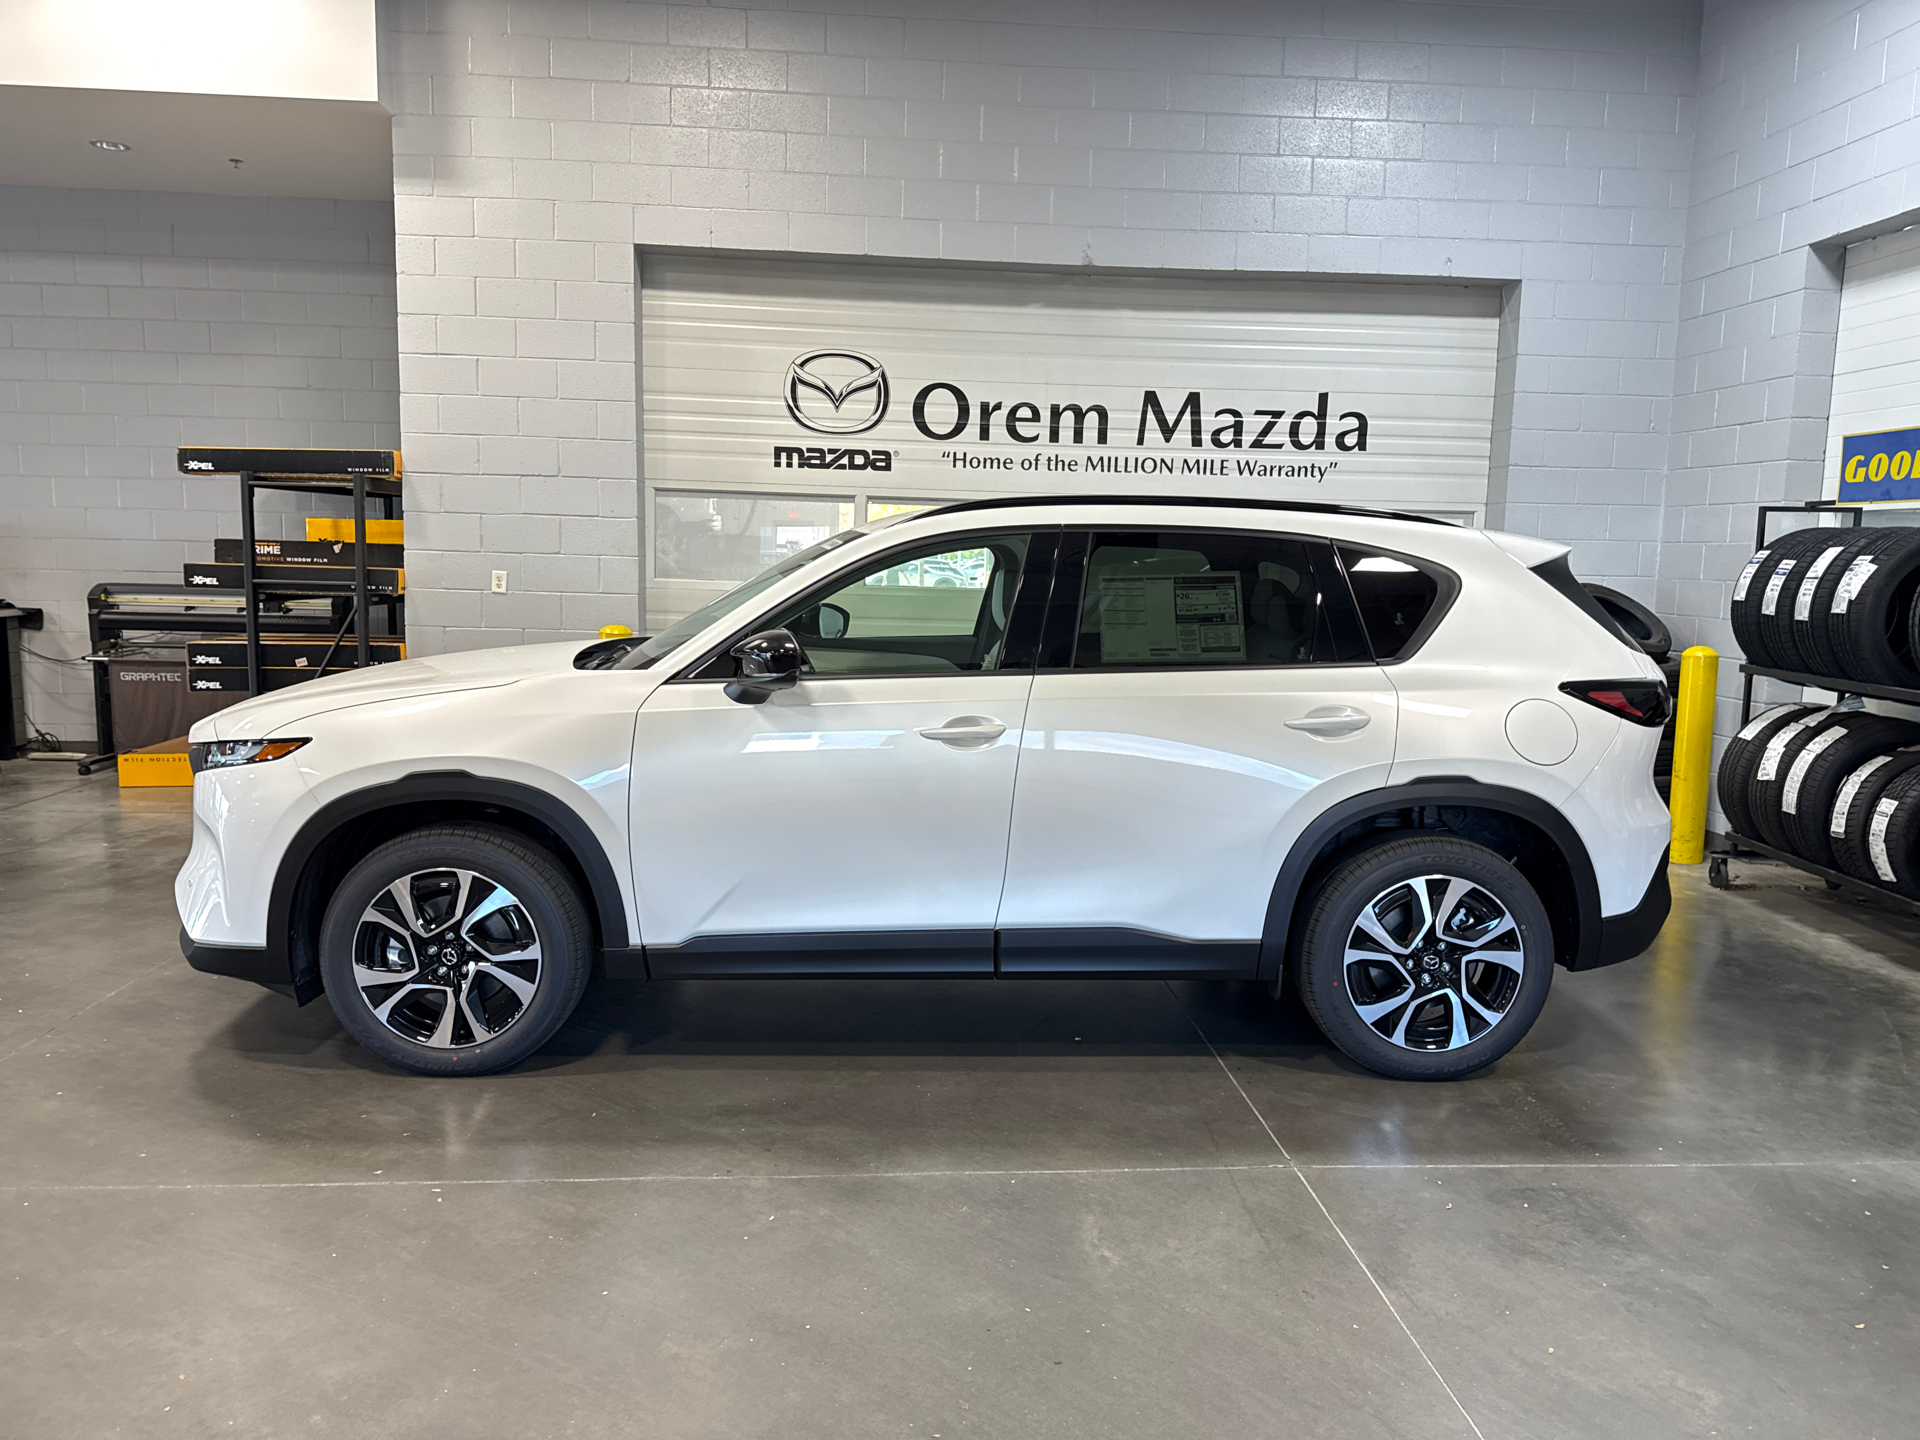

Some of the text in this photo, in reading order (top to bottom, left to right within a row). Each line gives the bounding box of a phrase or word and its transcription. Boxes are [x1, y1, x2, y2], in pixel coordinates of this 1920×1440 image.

[912, 382, 1368, 452] Orem Mazda
[186, 461, 215, 470] XPEL
[1020, 453, 1042, 471] of
[1046, 454, 1079, 472] the
[1085, 455, 1174, 474] MILLION
[1181, 458, 1230, 476] MILE
[254, 545, 281, 555] RIME
[191, 575, 220, 585] XPEL
[194, 655, 222, 664] XPEL
[120, 672, 181, 682] GRAPHTEC
[195, 680, 222, 690] XPEL
[1420, 855, 1517, 892] TOYO TIRES
